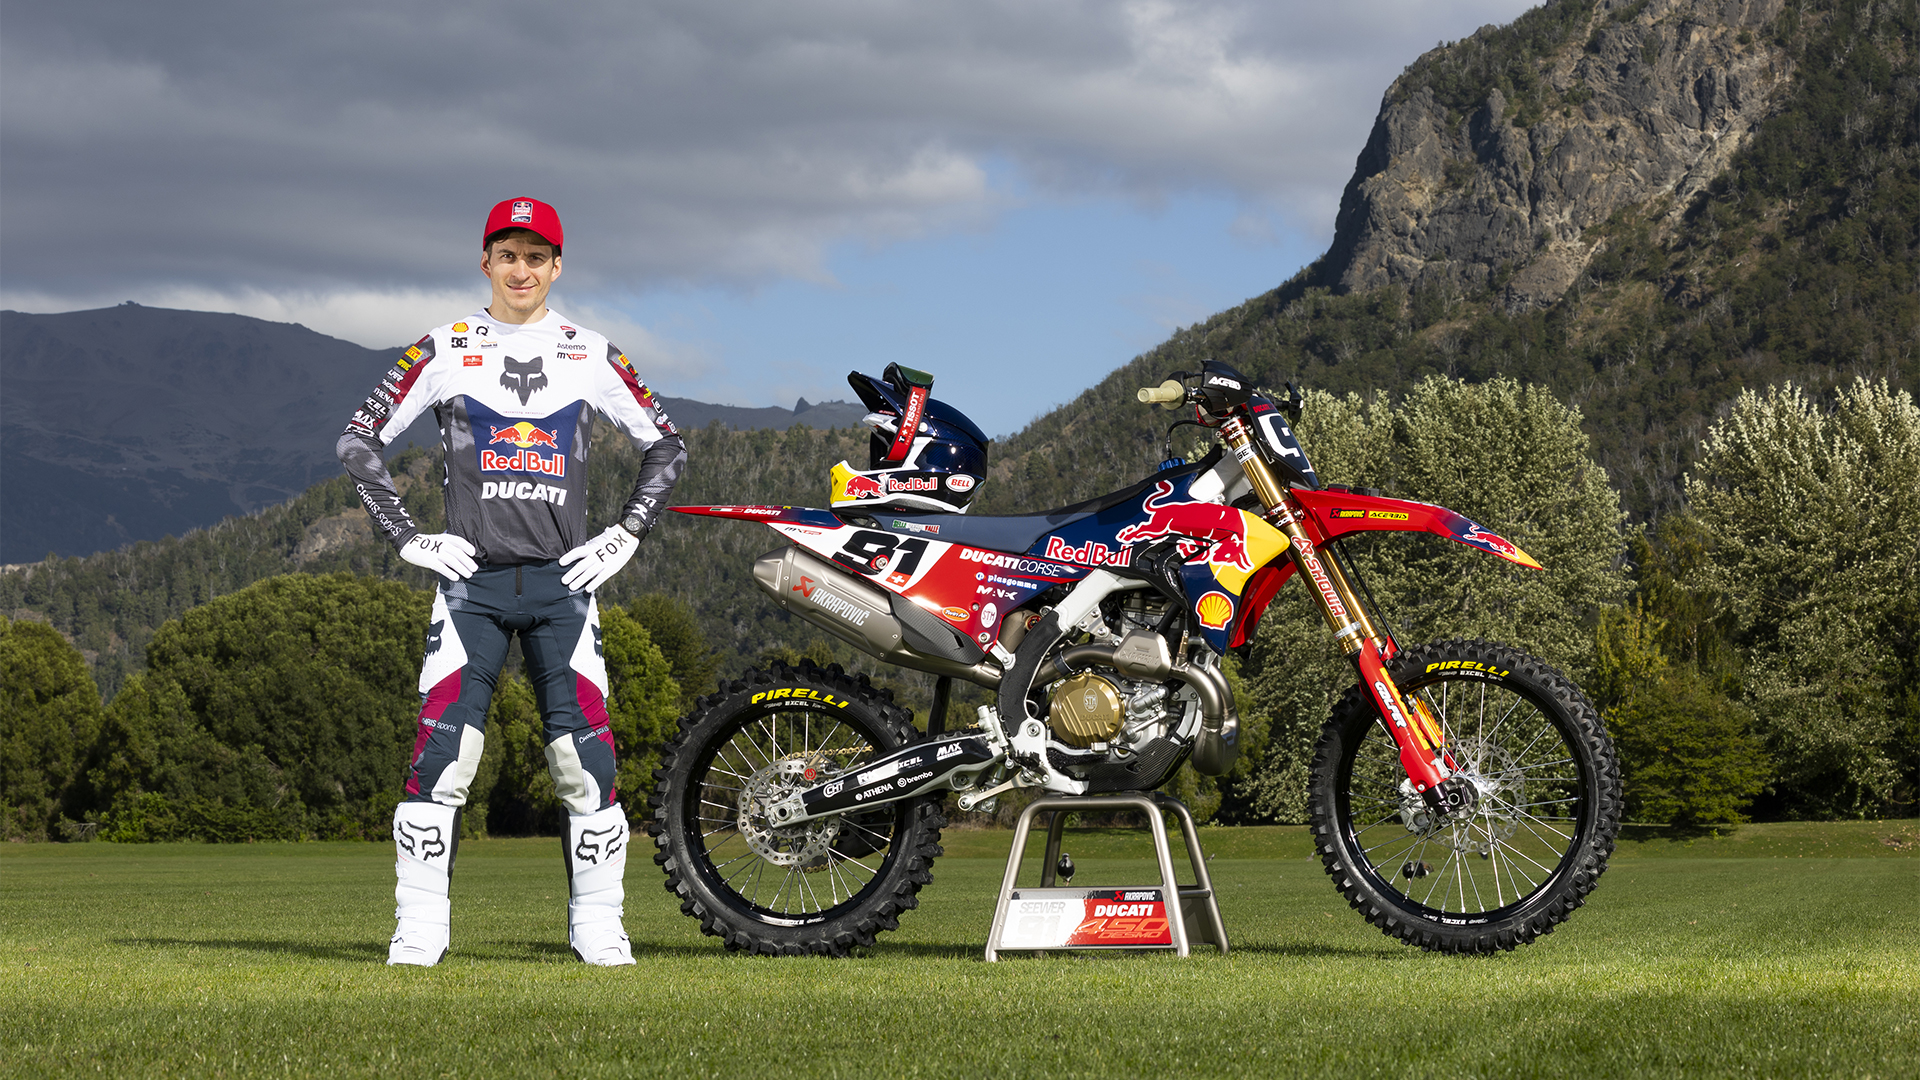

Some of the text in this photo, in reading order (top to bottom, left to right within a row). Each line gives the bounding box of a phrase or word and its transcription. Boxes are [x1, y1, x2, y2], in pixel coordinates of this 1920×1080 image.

[557, 342, 587, 351] Astemo
[903, 391, 920, 428] TISSOT
[481, 450, 566, 477] Red Bull
[888, 477, 938, 491] Red Bull
[951, 478, 970, 488] BELL
[356, 483, 381, 514] CHRIS
[481, 482, 568, 507] DUCATI
[743, 508, 781, 516] DUCATI
[410, 535, 443, 553] FOX
[595, 533, 628, 563] FOX
[1044, 535, 1134, 568] Red Bull
[832, 530, 930, 577] 91
[959, 548, 1062, 577] DUCATI CORSE
[987, 574, 1038, 591] plasgomma
[1305, 557, 1347, 617] SHOWA
[810, 587, 871, 627] AKRAPOVIČ
[944, 606, 959, 616] Twin
[981, 610, 996, 622] STM
[1425, 660, 1510, 678] PIRELLI
[1460, 669, 1485, 678] EXCEL
[751, 687, 850, 709] PIRELLI
[936, 742, 962, 757] MAX
[893, 756, 923, 769] XCEL
[906, 770, 934, 785] brembo
[863, 782, 894, 799] ATHENA
[1018, 901, 1067, 914] SEEWER
[1094, 904, 1154, 917] DUCATI
[1073, 918, 1170, 935] 450
[1097, 931, 1163, 939] DESMO
